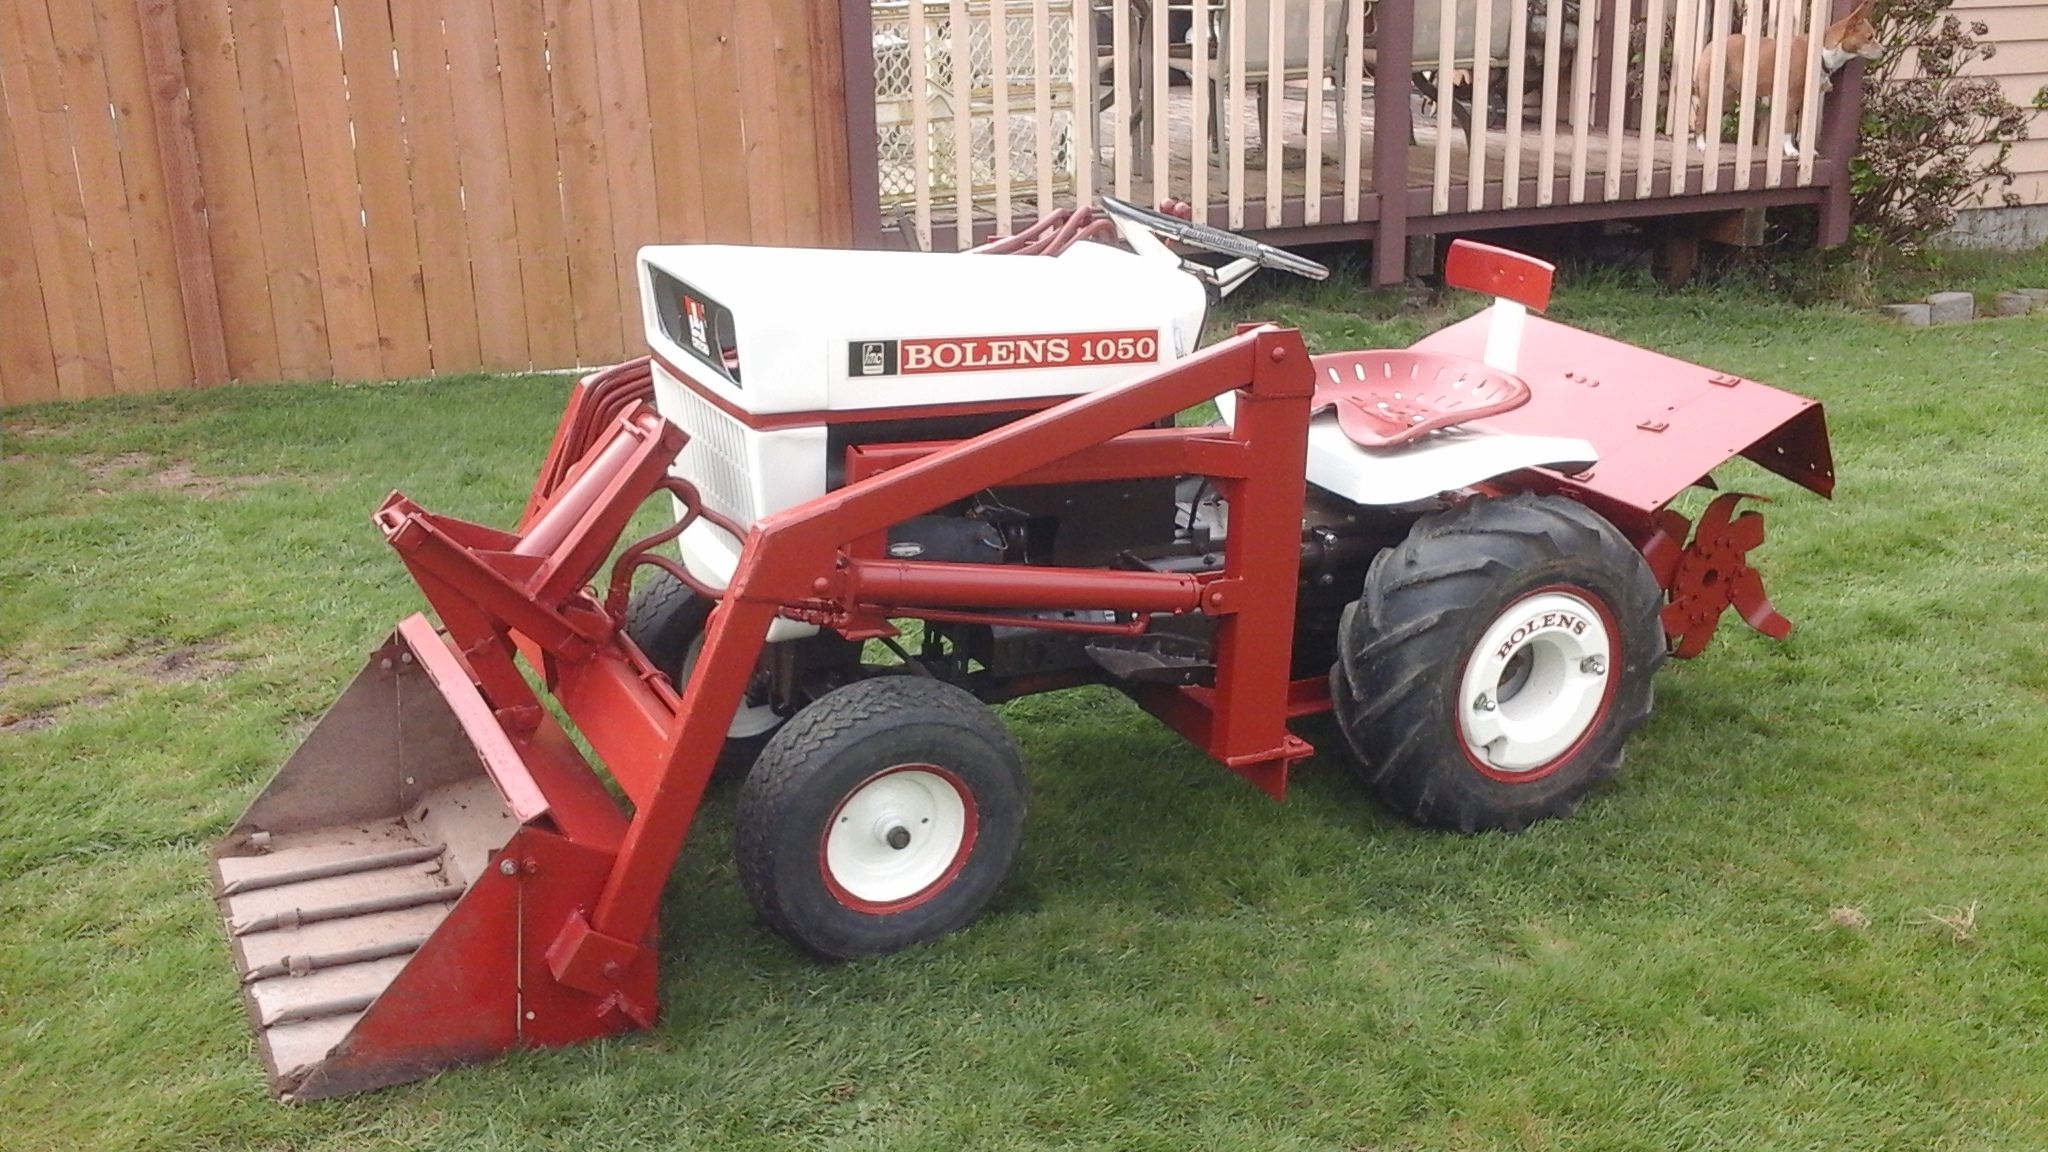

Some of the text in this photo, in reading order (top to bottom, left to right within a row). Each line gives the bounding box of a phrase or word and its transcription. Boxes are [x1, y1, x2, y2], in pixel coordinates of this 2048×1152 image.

[904, 337, 1156, 369] BOLENS 1050
[1497, 613, 1588, 661] BOLENS
